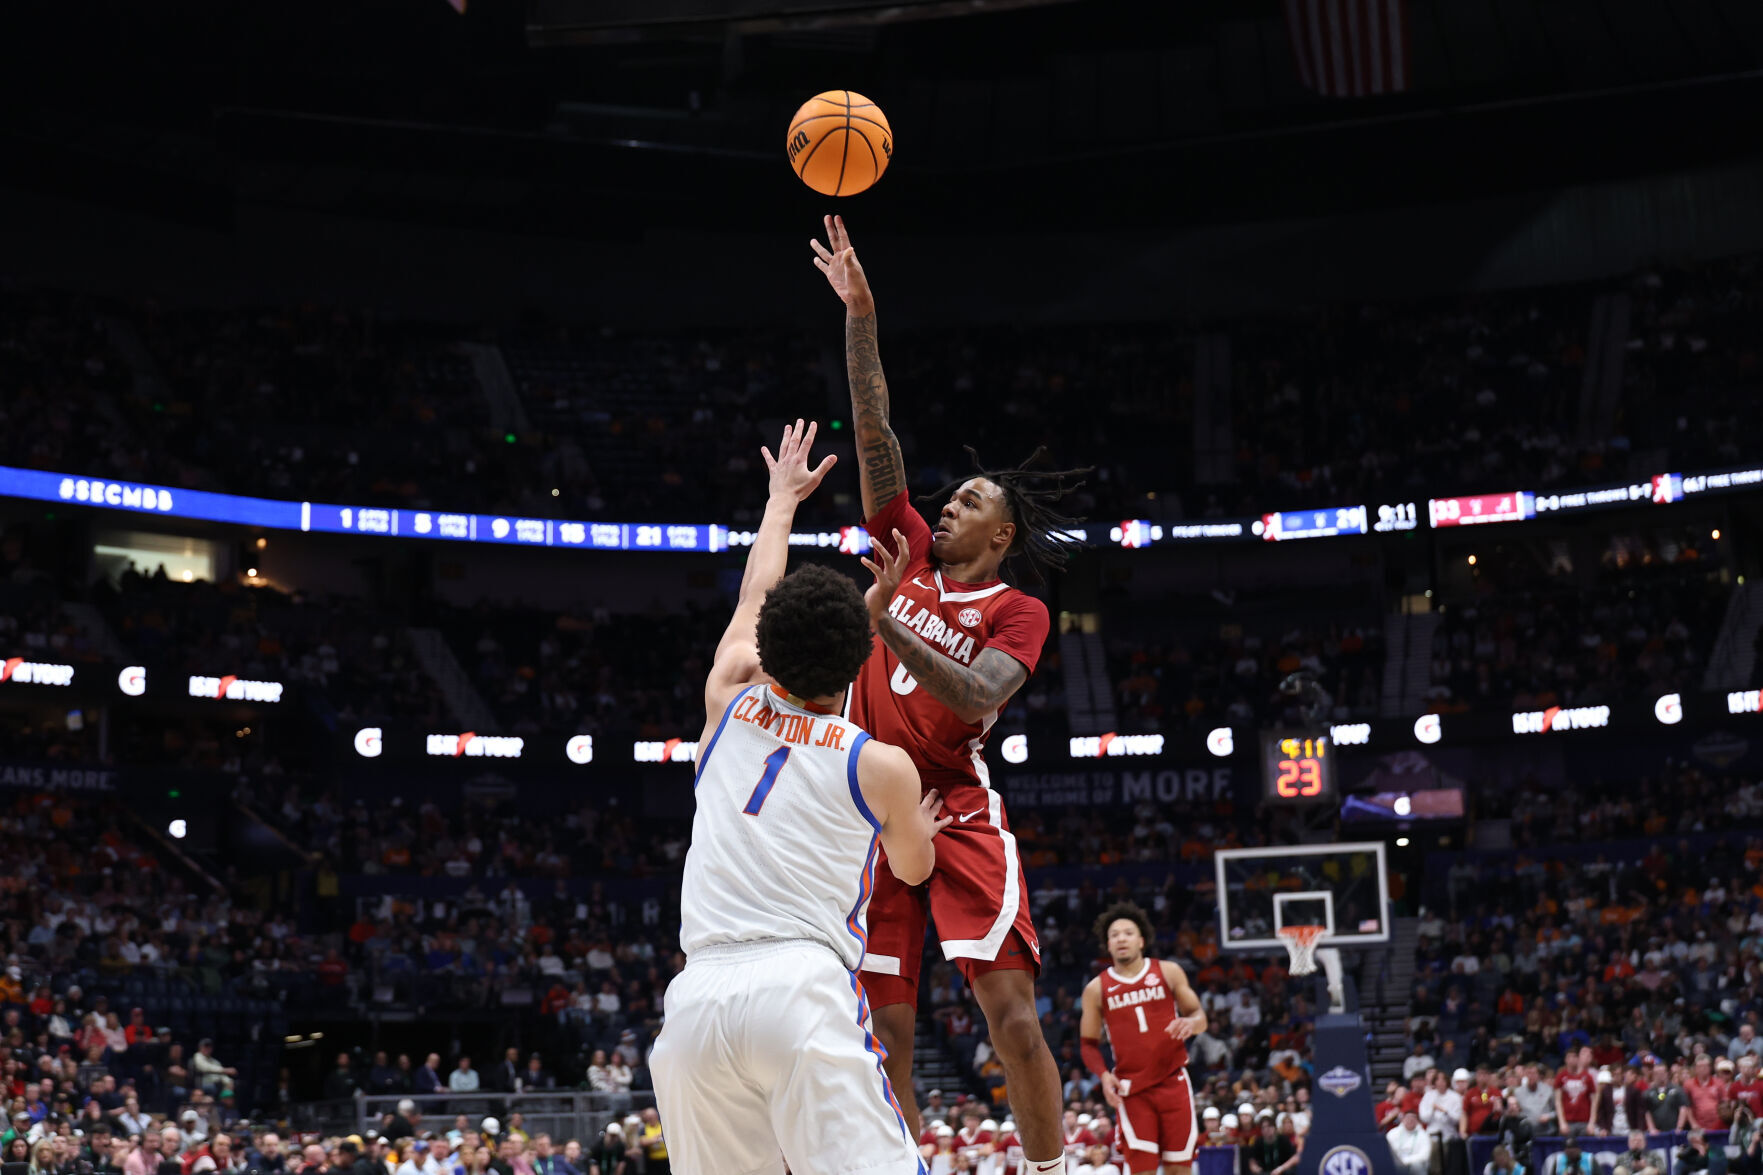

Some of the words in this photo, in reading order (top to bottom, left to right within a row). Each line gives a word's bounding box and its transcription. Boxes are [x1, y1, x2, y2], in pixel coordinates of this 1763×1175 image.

[888, 594, 976, 664] ALABAMA
[118, 666, 146, 696] G
[733, 695, 816, 745] CLAYTON
[815, 722, 846, 751] JR.
[1654, 693, 1683, 725] G
[354, 727, 382, 758] G
[1206, 727, 1234, 757] G
[1414, 713, 1442, 744] G
[566, 734, 593, 764] G
[1001, 734, 1029, 764] G
[742, 745, 792, 817] 1
[1277, 758, 1321, 798] 23
[1107, 985, 1166, 1011] ALABAMA
[1134, 1006, 1149, 1033] 1
